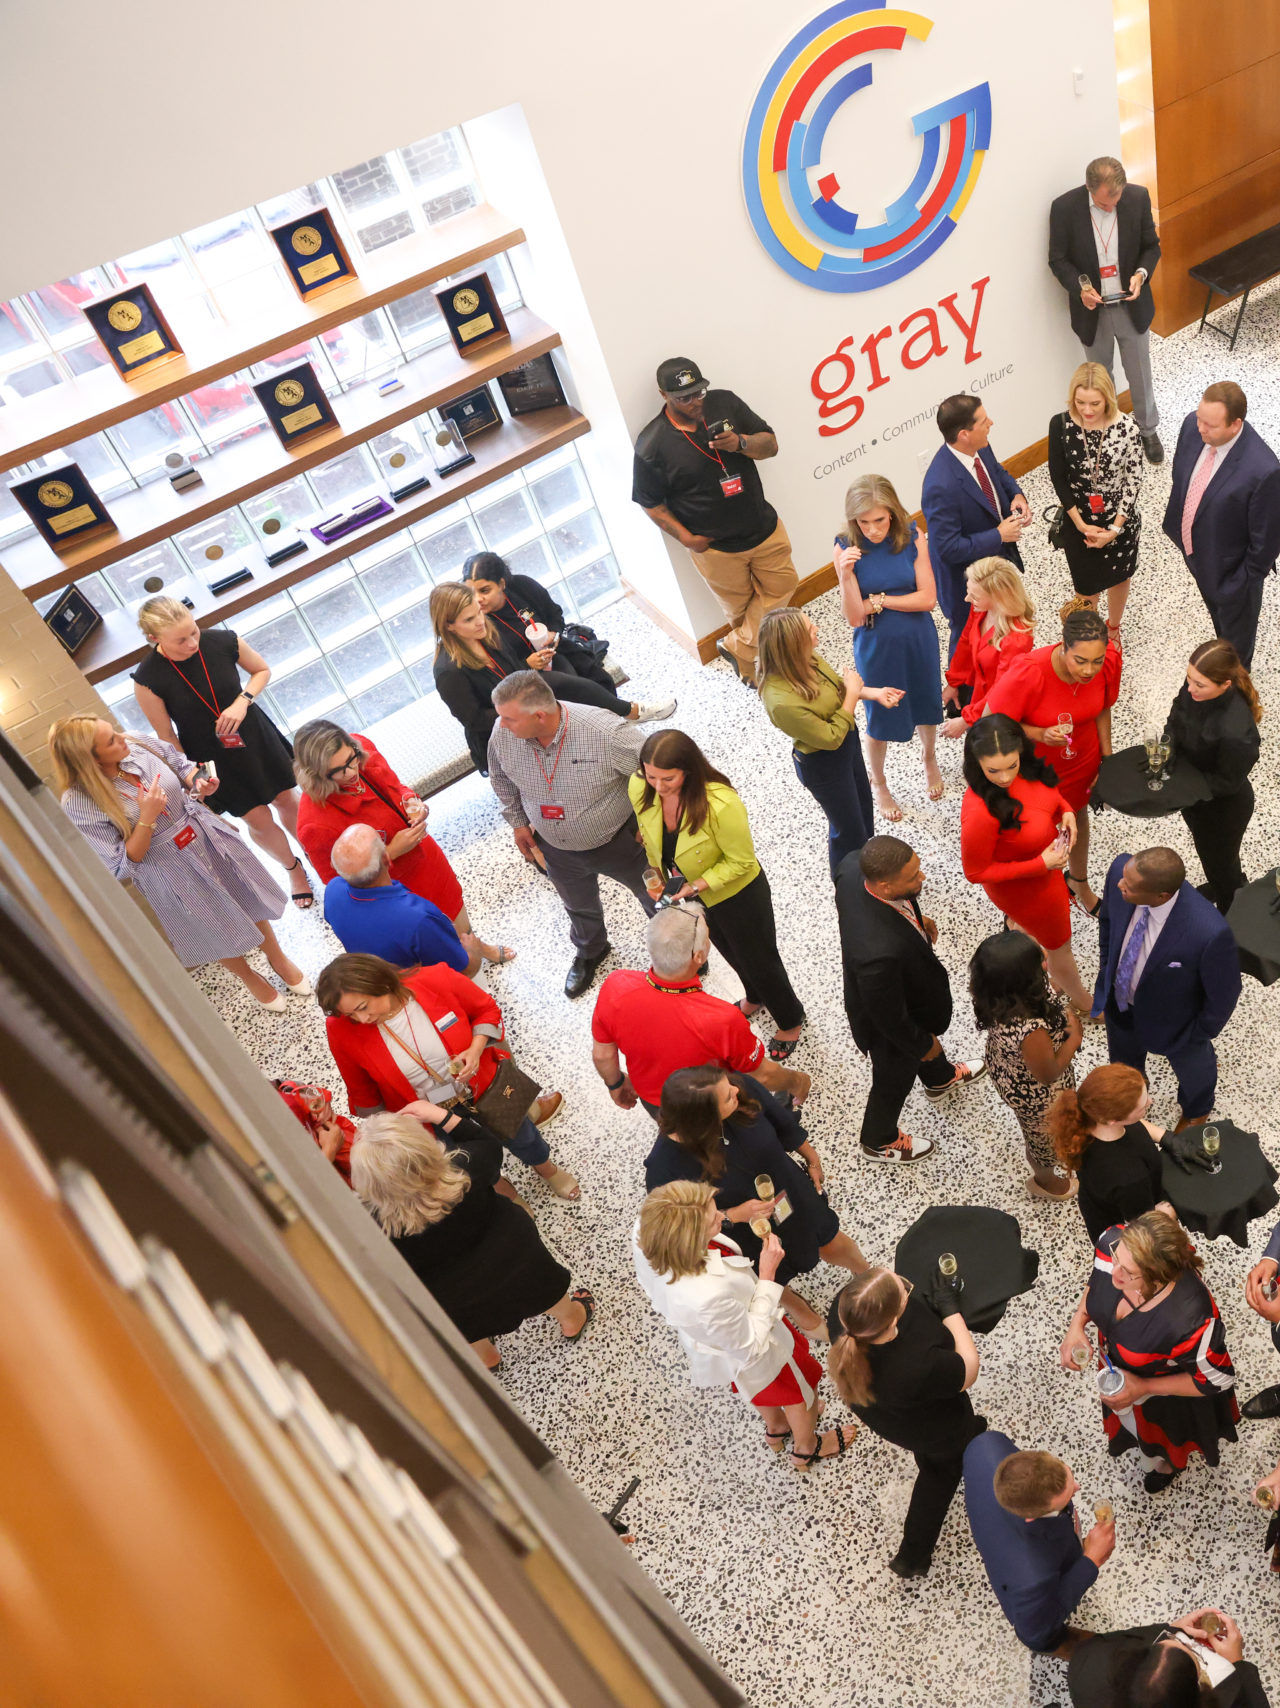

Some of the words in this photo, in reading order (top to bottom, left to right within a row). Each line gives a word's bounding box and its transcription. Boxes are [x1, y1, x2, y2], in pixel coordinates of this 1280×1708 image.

[811, 276, 990, 436] gray
[813, 443, 868, 480] Content
[970, 363, 1014, 394] Culture
